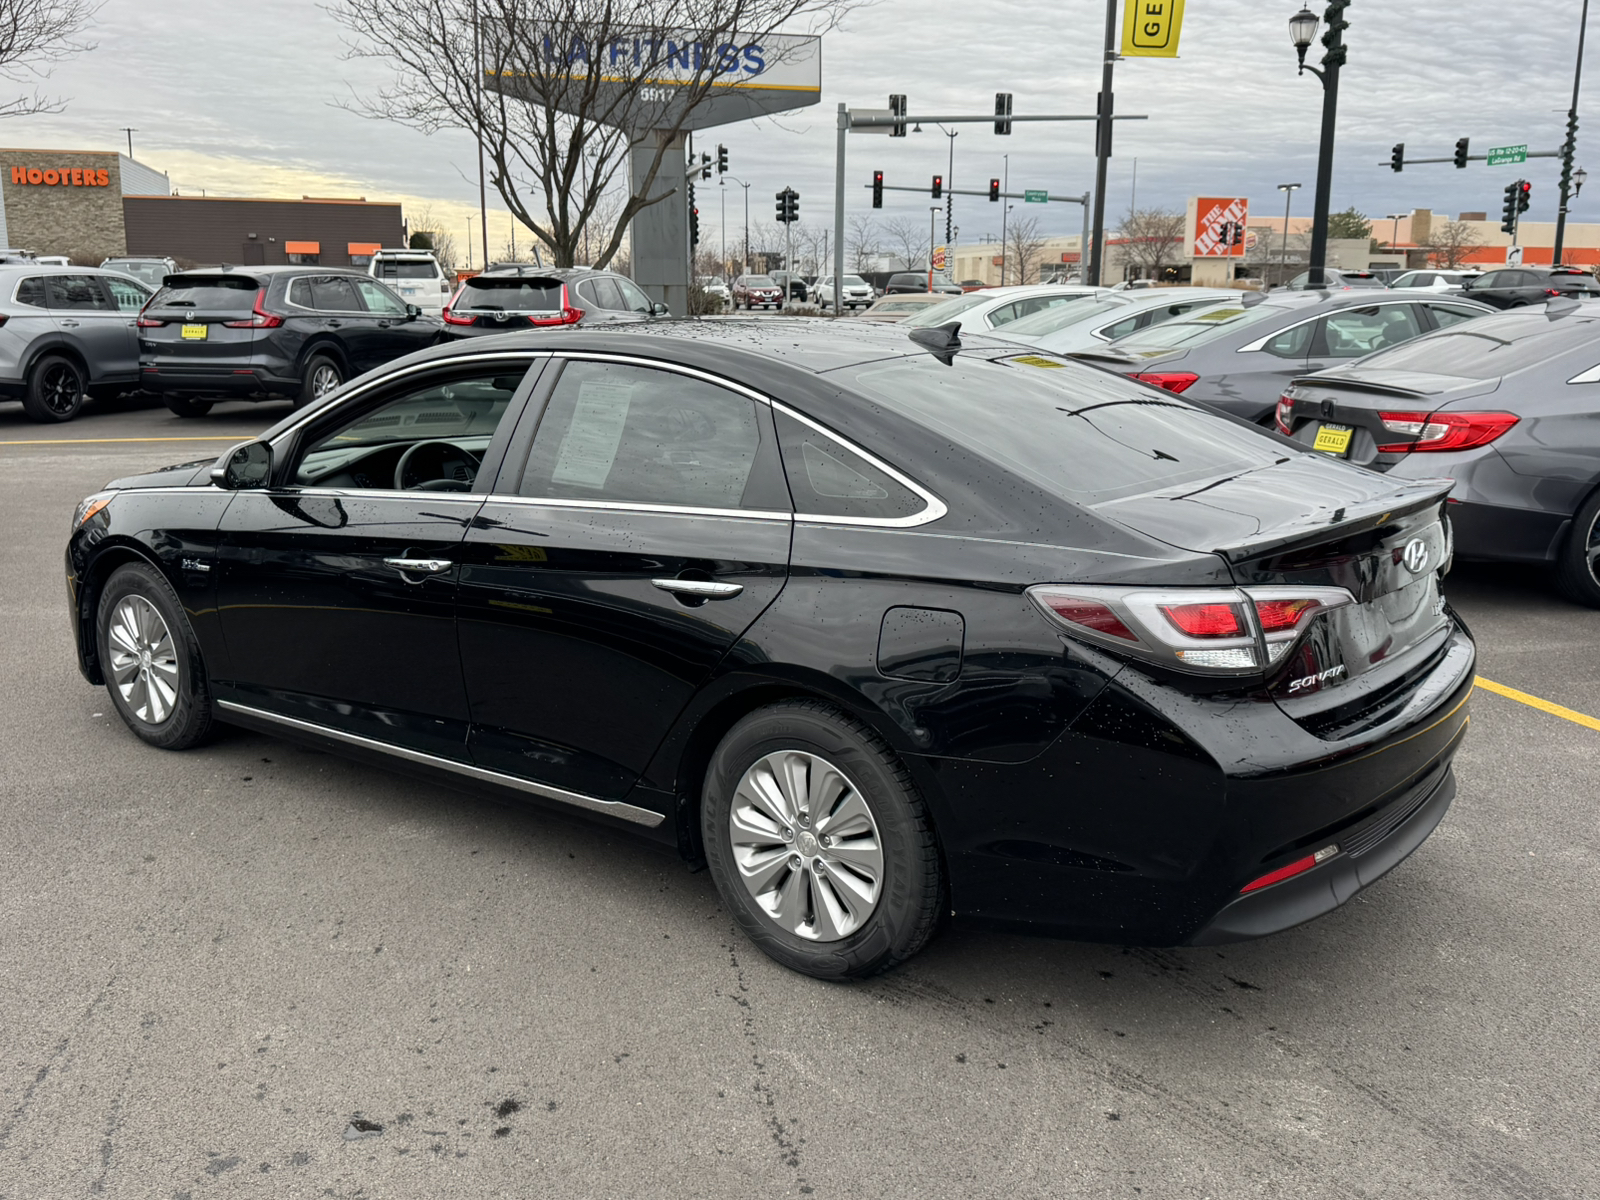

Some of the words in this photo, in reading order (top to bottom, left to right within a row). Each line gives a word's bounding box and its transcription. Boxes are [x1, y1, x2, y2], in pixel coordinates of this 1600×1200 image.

[1143, 3, 1163, 37] GE
[543, 34, 589, 65] LA
[609, 38, 765, 74] FITNESS
[11, 166, 110, 187] HOOTERS
[1194, 198, 1247, 256] HOME
[1200, 204, 1224, 227] THE
[1325, 423, 1346, 431] GERALD
[1319, 435, 1344, 446] GERALD
[1288, 664, 1345, 693] SONATA
